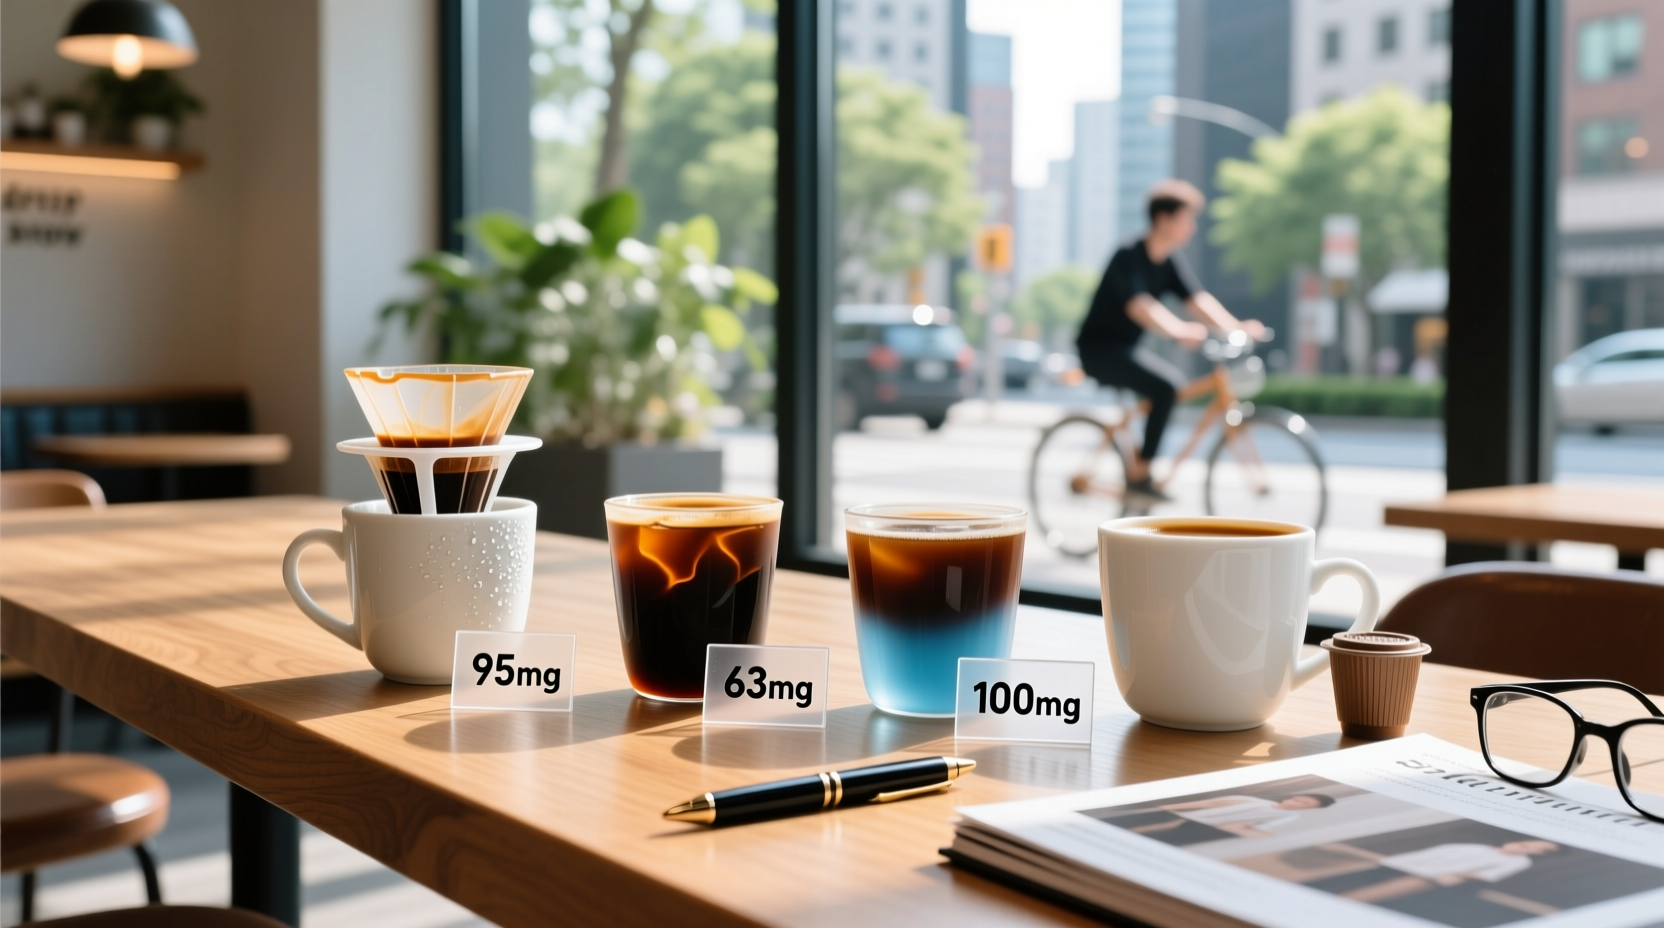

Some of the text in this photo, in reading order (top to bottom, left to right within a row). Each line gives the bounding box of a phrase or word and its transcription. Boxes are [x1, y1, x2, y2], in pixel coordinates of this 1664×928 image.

[472, 652, 561, 694] 95mg
[724, 665, 813, 708] 63mg
[973, 681, 1081, 725] 100mg
